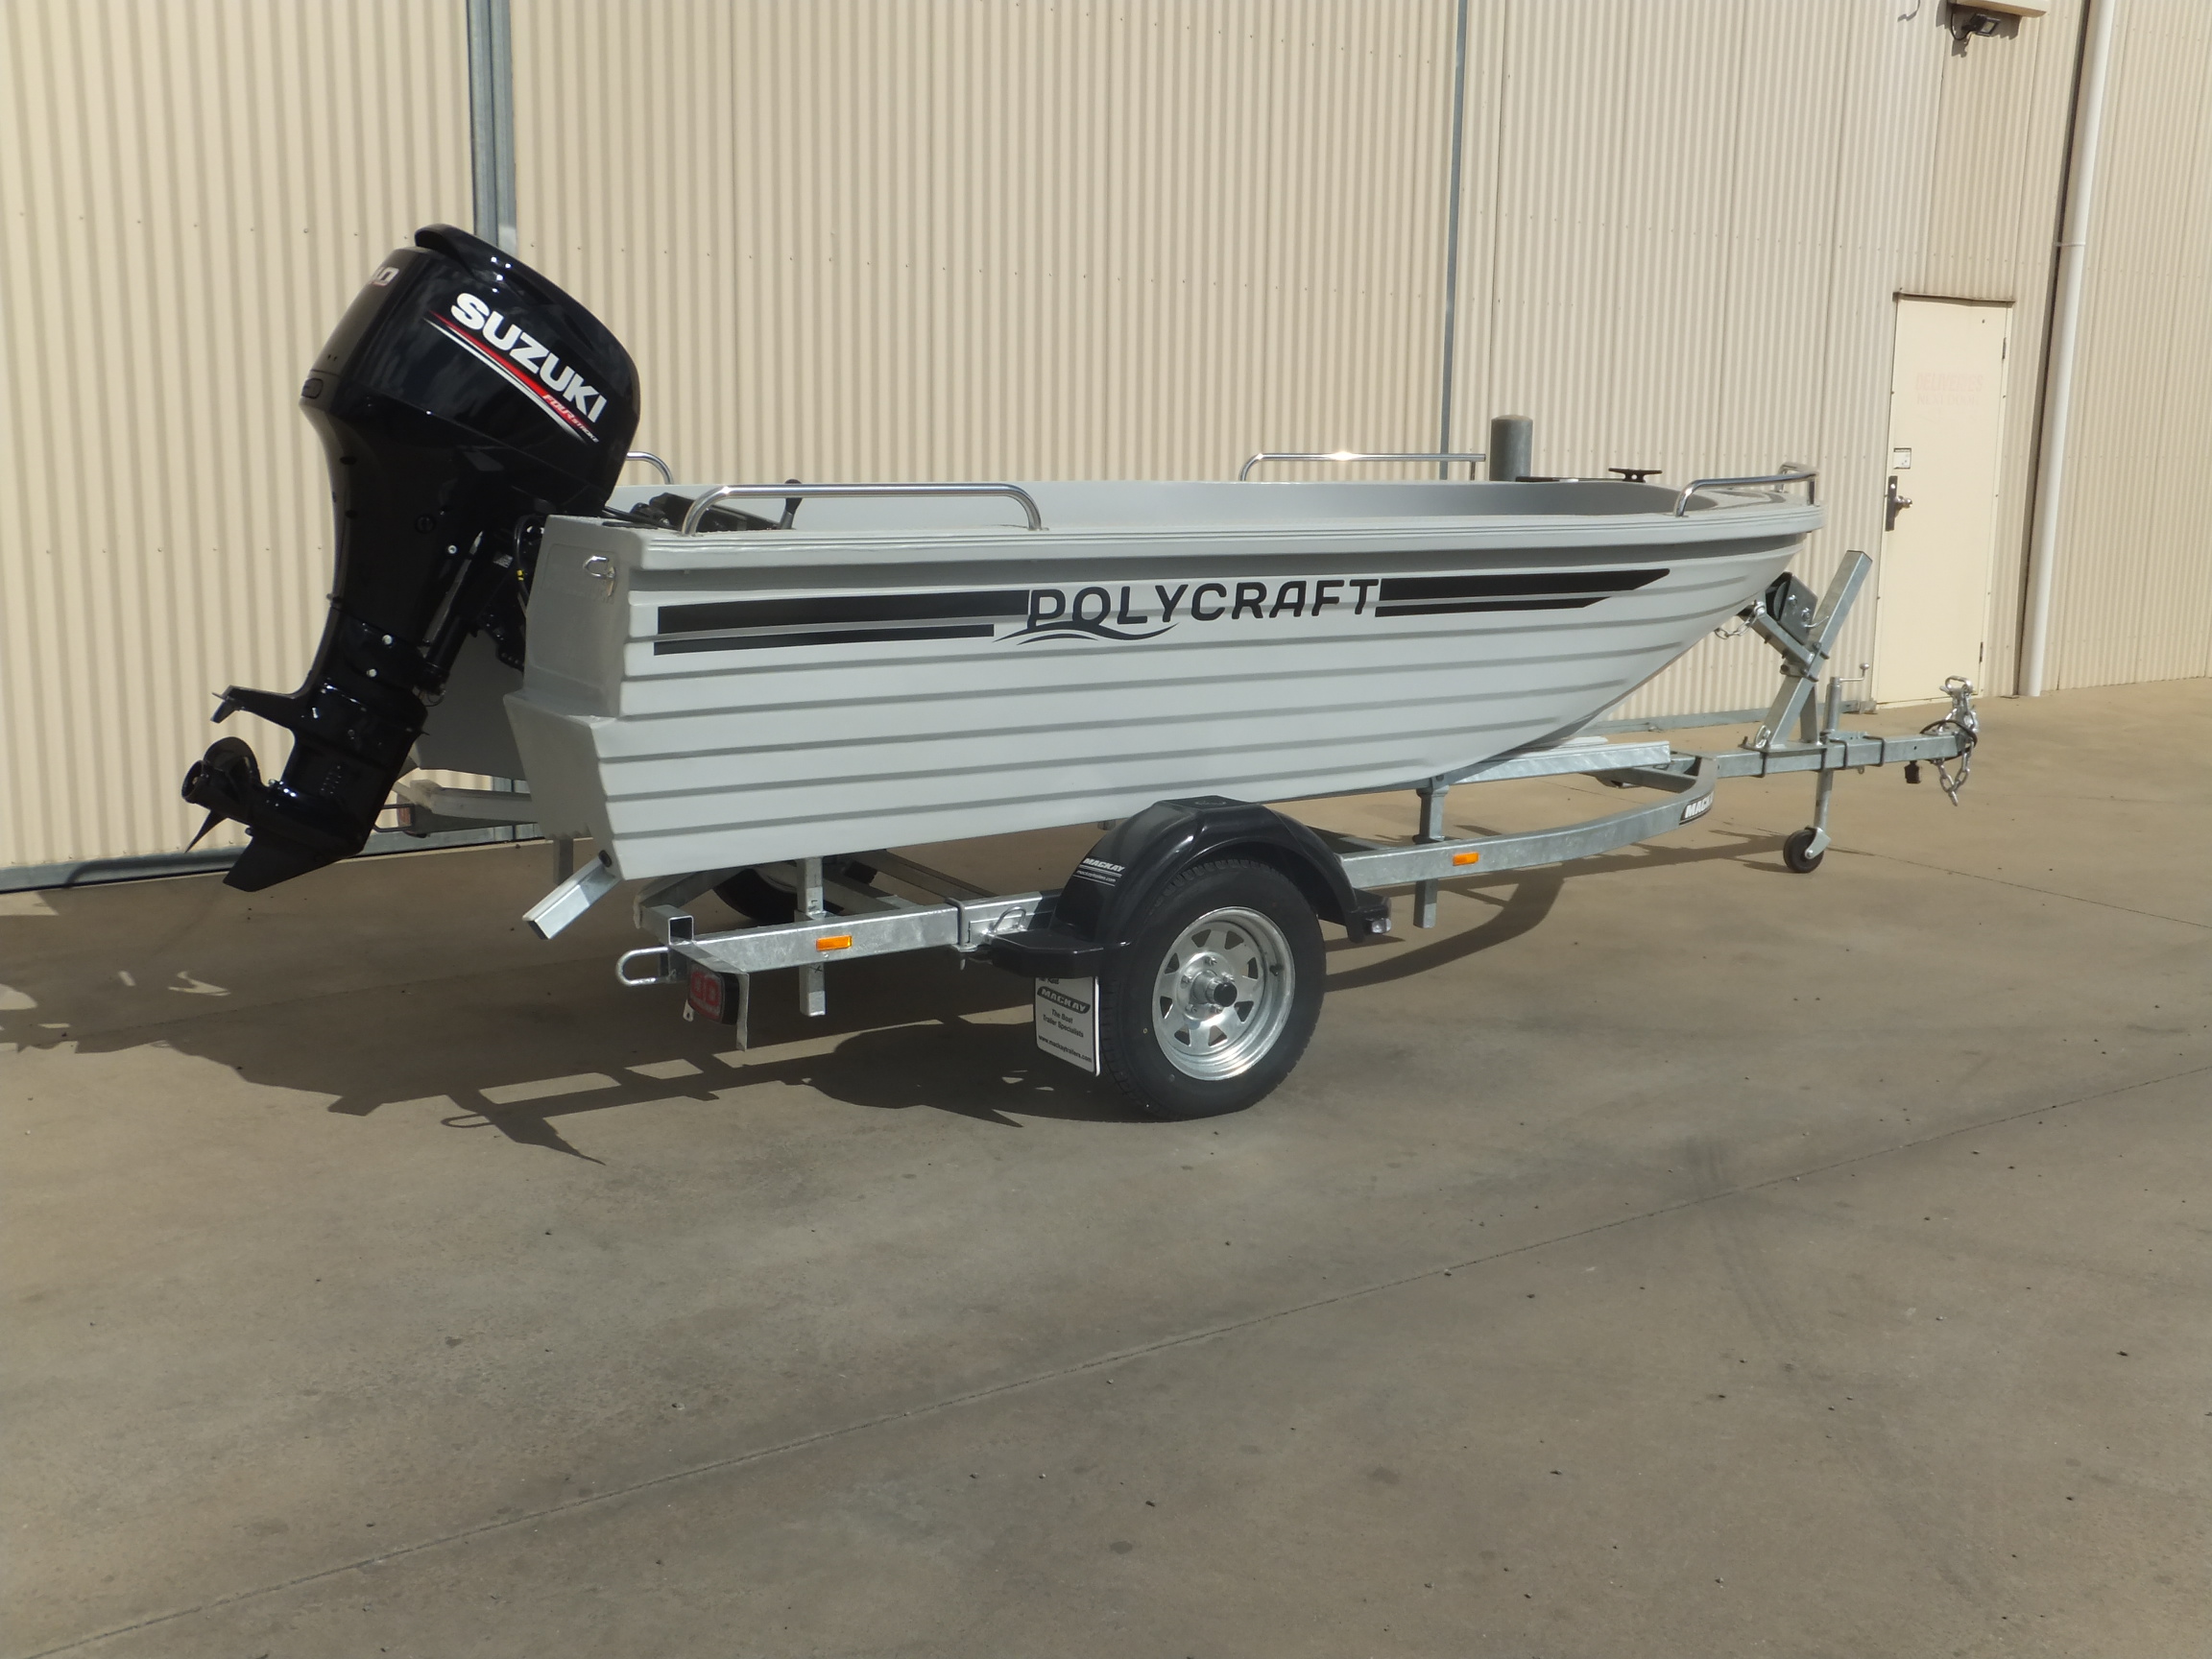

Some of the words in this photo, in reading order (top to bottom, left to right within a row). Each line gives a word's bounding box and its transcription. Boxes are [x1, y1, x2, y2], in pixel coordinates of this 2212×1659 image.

[450, 292, 608, 423] SUZUKI
[1916, 393, 1943, 406] NEXT
[1027, 578, 1380, 630] POLYCRAFT
[1082, 857, 1125, 873] MACKAY
[1041, 988, 1086, 1012] MACKAY
[1043, 1014, 1057, 1026] Trailer
[1057, 1021, 1084, 1038] Specialists
[1051, 1008, 1061, 1019] The
[1061, 1013, 1073, 1023] Boat
[1038, 1035, 1093, 1063] www.mackaytrailers.com
